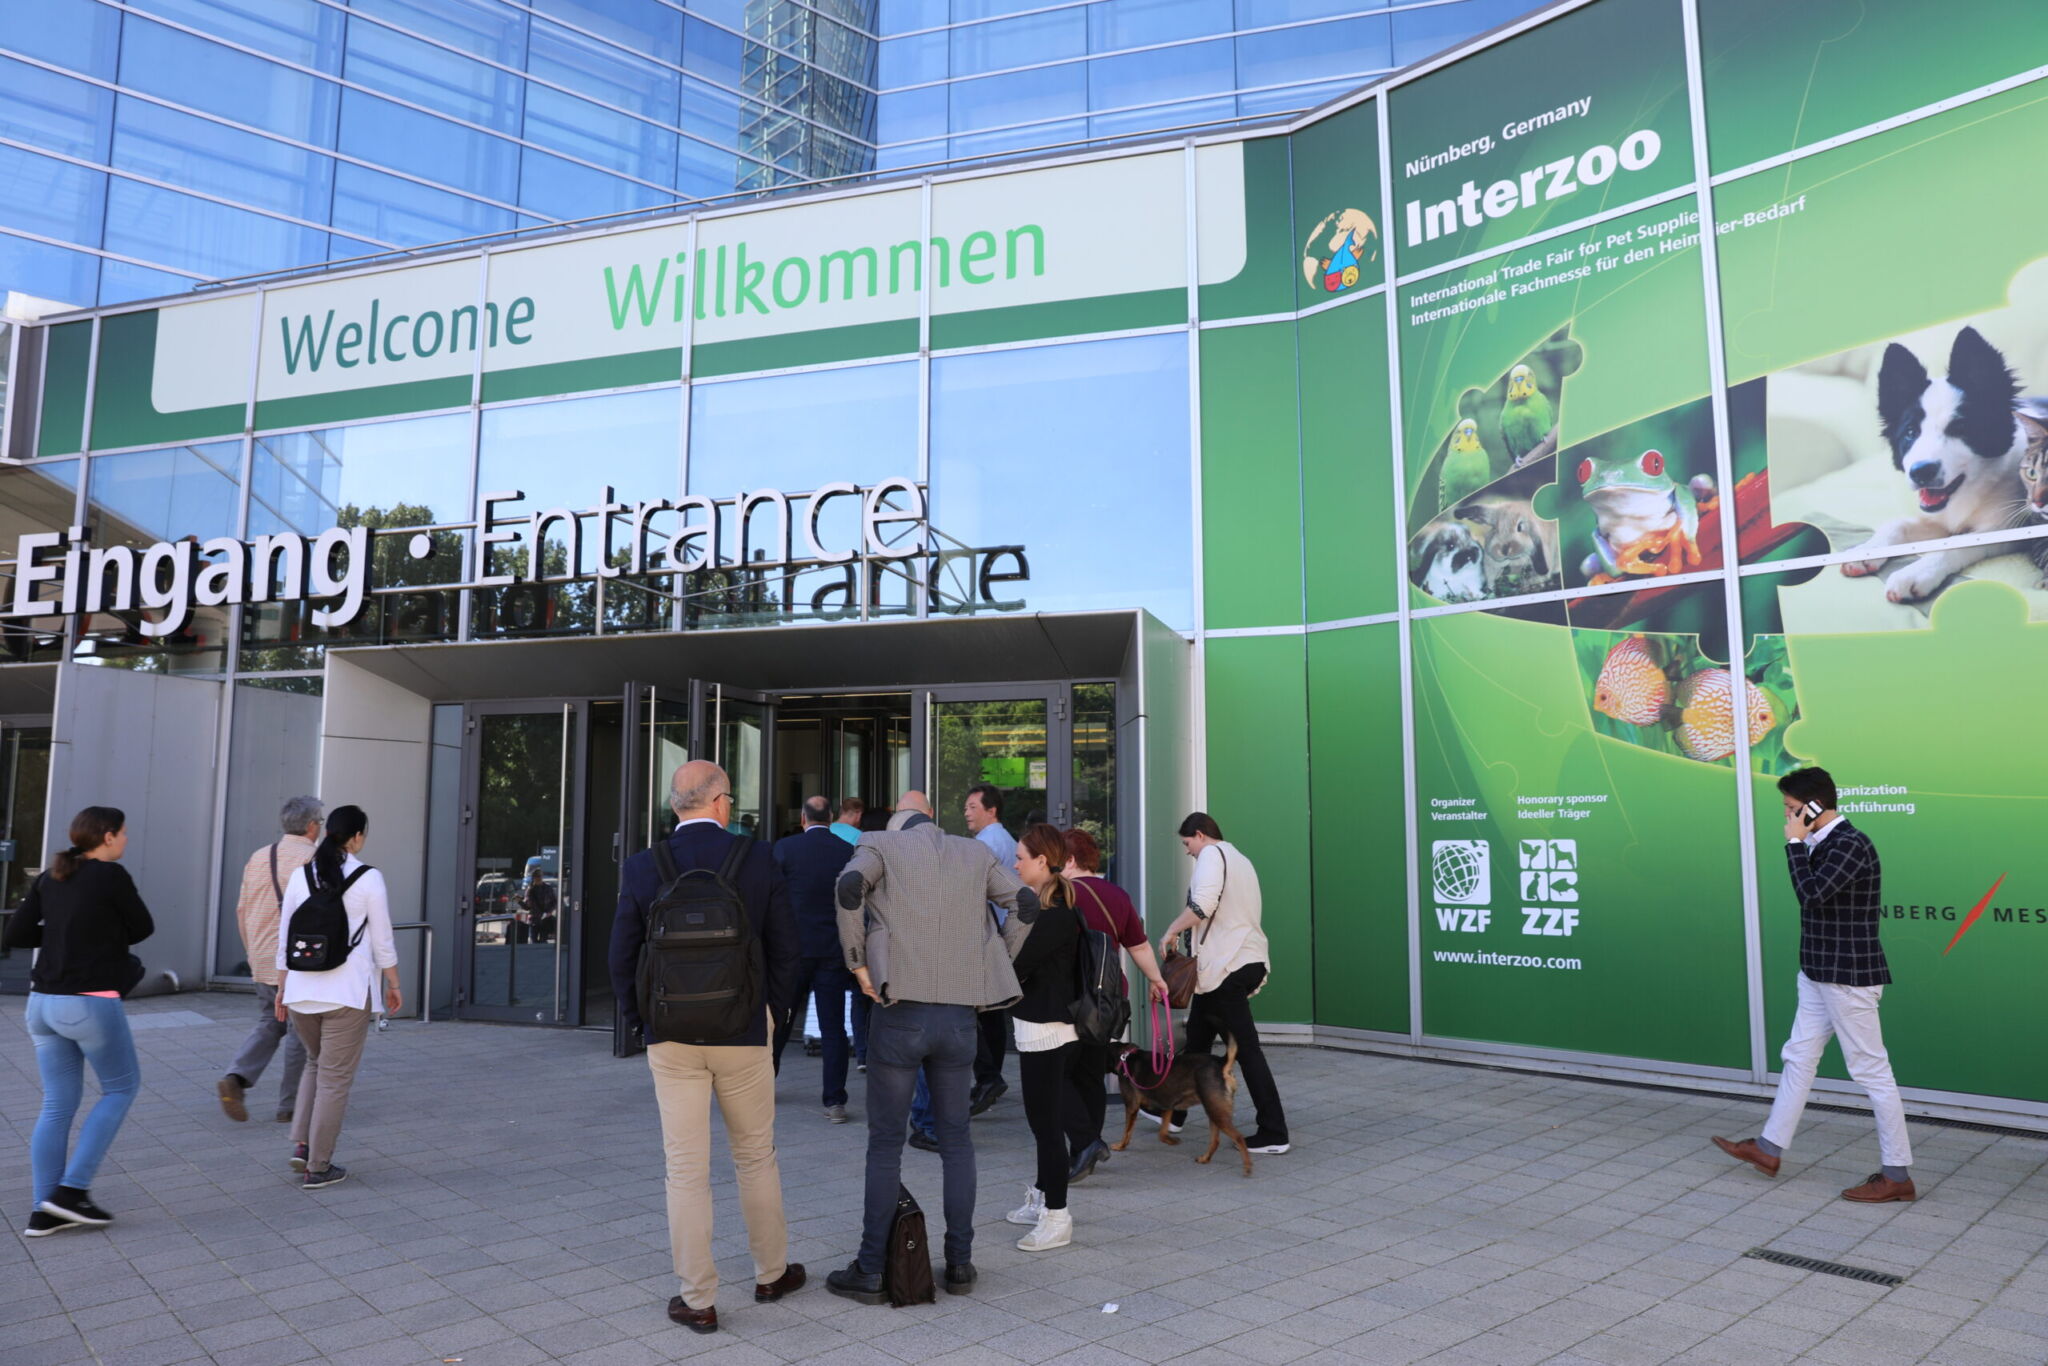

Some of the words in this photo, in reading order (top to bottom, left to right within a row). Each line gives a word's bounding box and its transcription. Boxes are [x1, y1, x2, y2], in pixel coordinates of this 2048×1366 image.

[1405, 134, 1496, 178] Nürnberg,
[1502, 96, 1592, 140] Germany
[1406, 129, 1661, 247] Interzoo
[1410, 269, 1498, 308] International
[1501, 258, 1542, 280] Trade
[1546, 248, 1575, 267] Fair
[1579, 240, 1602, 257] for
[1606, 230, 1633, 249] Pet
[1637, 210, 1699, 240] Supplie
[1411, 288, 1507, 326] Internationale
[1511, 266, 1592, 297] Fachmesse
[1595, 255, 1619, 273] für
[1624, 246, 1654, 265] den
[1659, 196, 1807, 254] Heimier-Bedarf
[603, 224, 1045, 330] Willkommen
[281, 296, 535, 375] Welcome
[12, 525, 372, 637] Eingang
[474, 476, 927, 586] Entrance
[1431, 798, 1476, 810] Organizer
[1517, 795, 1564, 806] Honorary
[1566, 795, 1608, 806] sponsor
[1836, 784, 1908, 799] ganization
[1431, 810, 1488, 821] Veranstalter
[1518, 809, 1555, 819] Ideeller
[1558, 808, 1591, 821] Träger
[1837, 801, 1916, 815] rchführung
[1435, 907, 1492, 933] WZF
[1521, 907, 1580, 936] ZZF
[1879, 905, 1956, 921] NBERG
[1993, 907, 2048, 924] MES
[1433, 950, 1582, 970] www.interzoo.com
